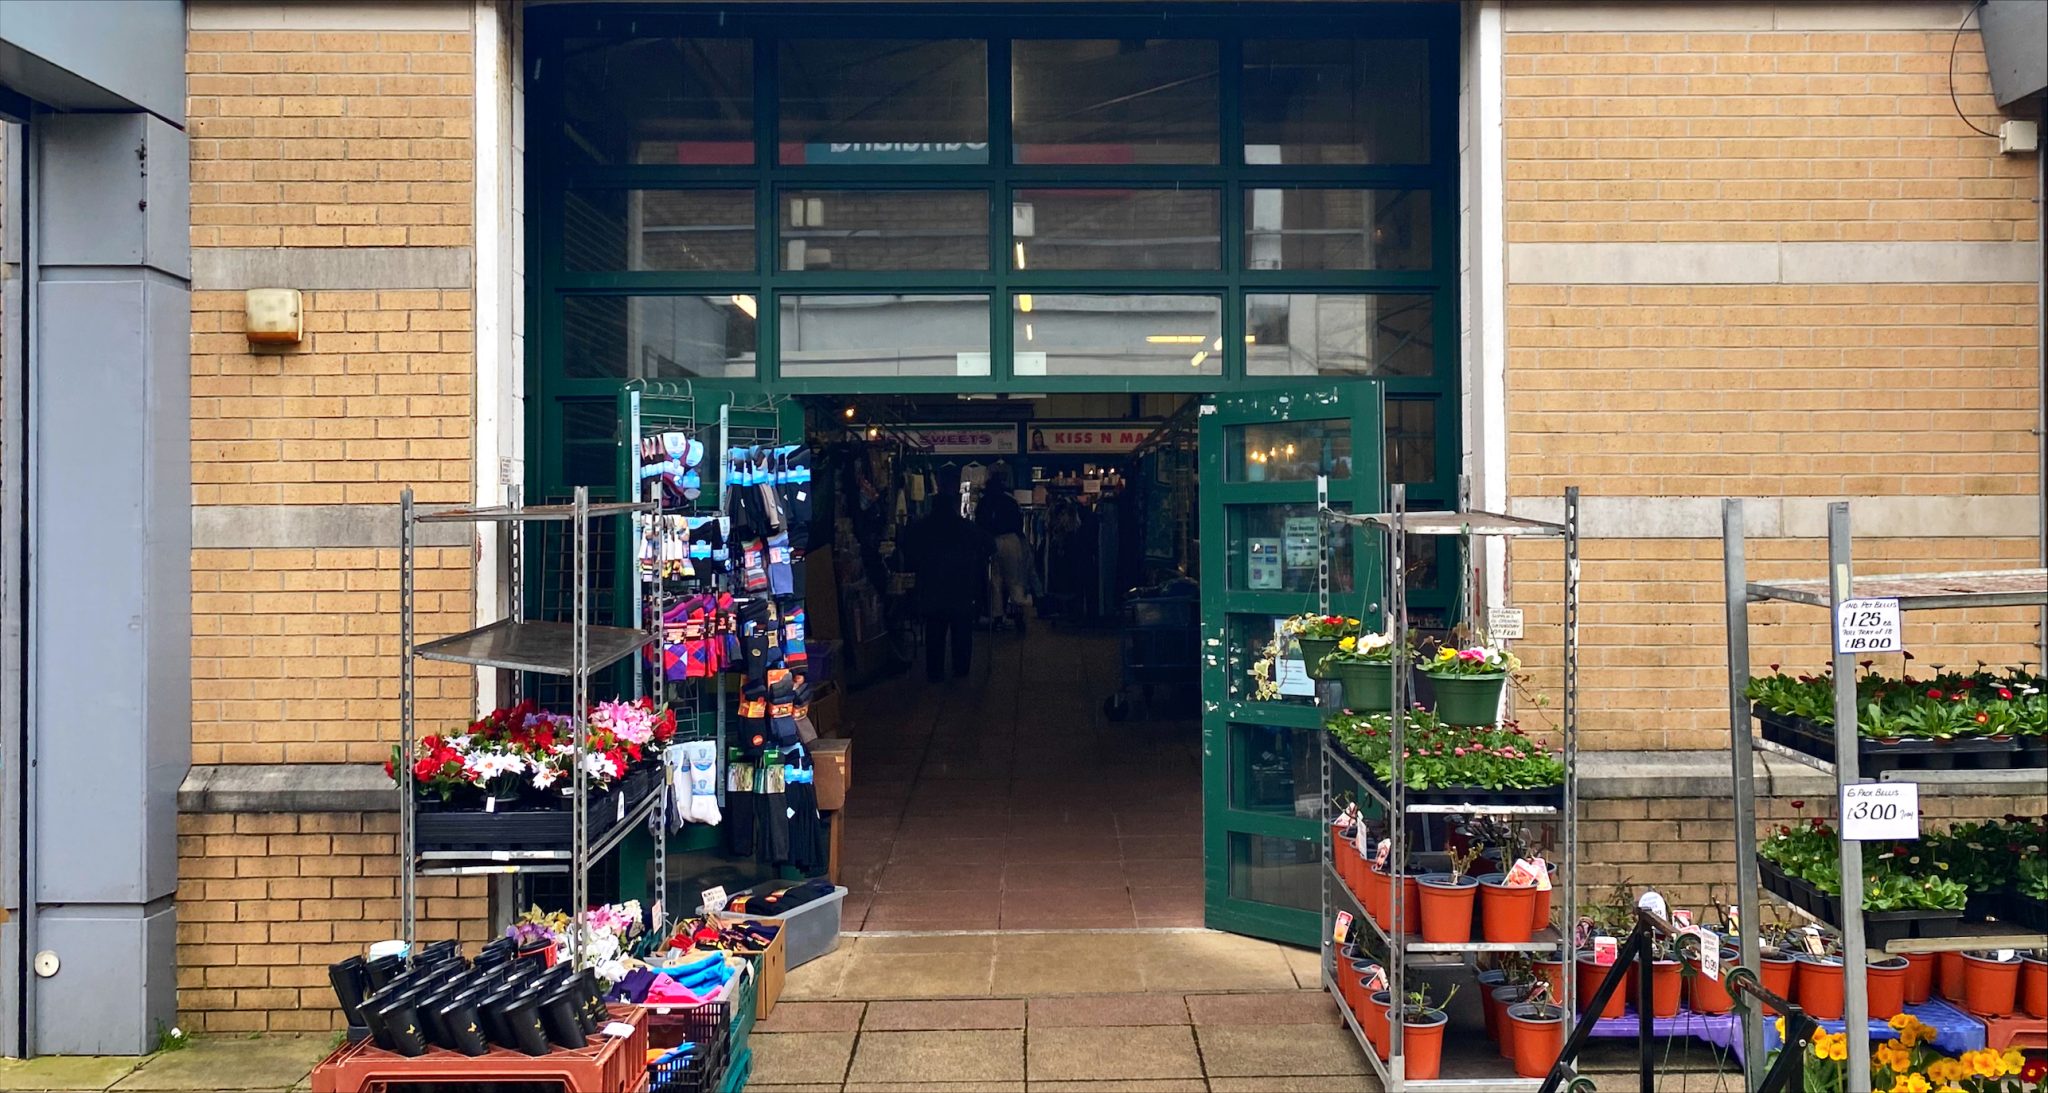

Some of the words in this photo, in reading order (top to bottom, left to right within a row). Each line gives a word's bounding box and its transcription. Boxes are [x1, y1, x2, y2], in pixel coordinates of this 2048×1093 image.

[919, 433, 992, 446] SWEETS
[1055, 432, 1093, 444] KISS
[1101, 432, 1112, 444] N
[1875, 788, 1899, 797] BELLIS
